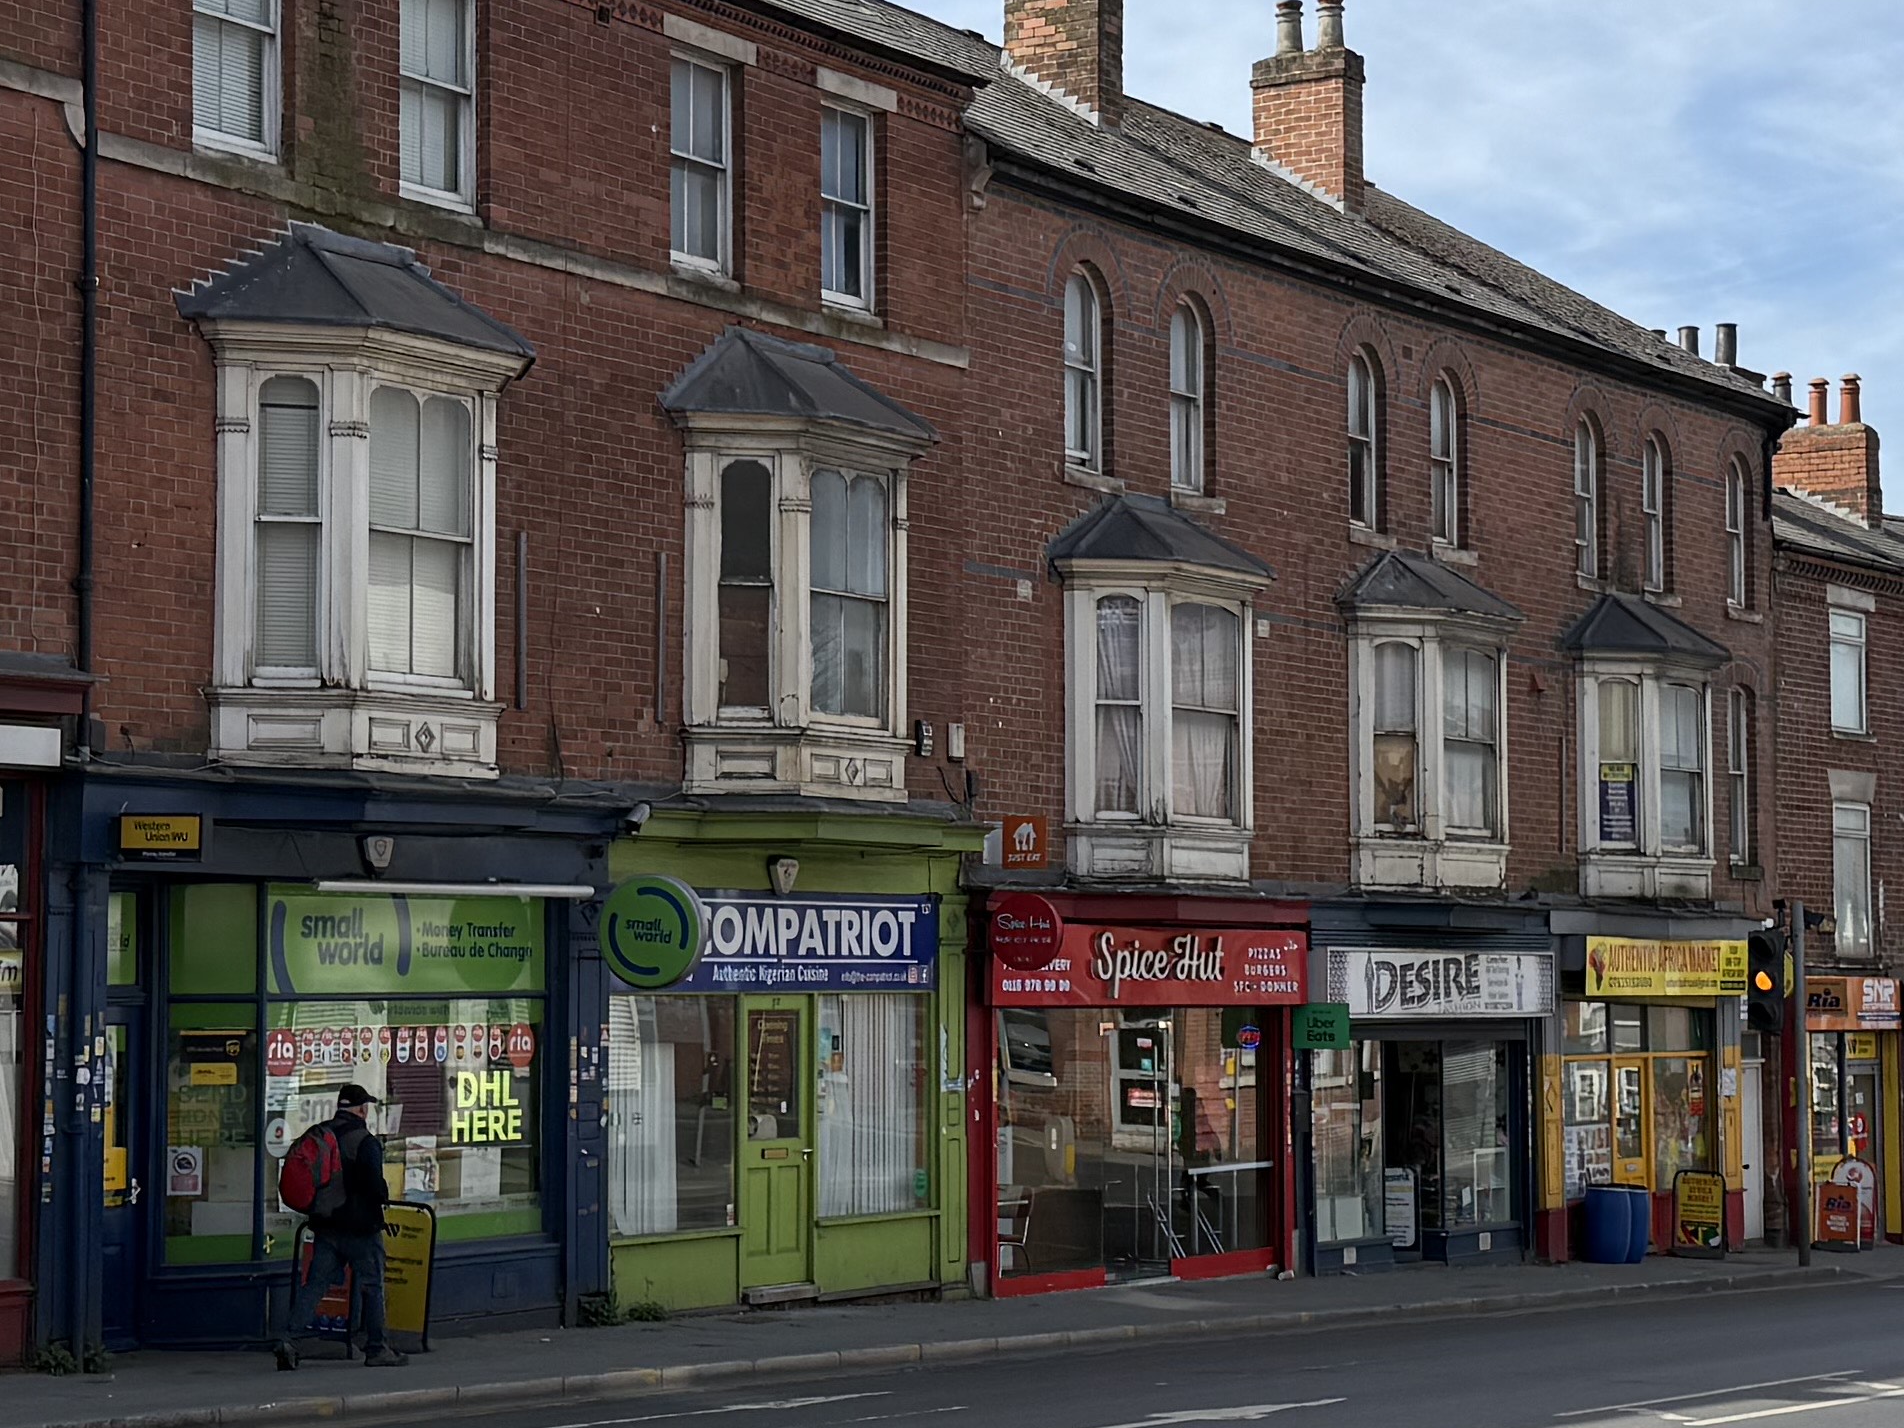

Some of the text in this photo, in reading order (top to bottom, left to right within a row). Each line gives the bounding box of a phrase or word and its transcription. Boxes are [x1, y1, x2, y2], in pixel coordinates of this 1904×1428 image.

[301, 907, 363, 939] small
[421, 922, 516, 941] Money Transfer
[625, 917, 662, 931] small
[633, 929, 672, 945] world
[317, 933, 384, 966] world
[421, 943, 466, 958] Bureau
[469, 943, 485, 958] de
[1247, 947, 1281, 960] PIZZAS
[1609, 944, 1656, 972] AUTHENTIC
[712, 965, 757, 982] Authentic
[1096, 931, 1225, 1000] Spice Hut
[1374, 953, 1482, 1012] DESIRE
[1807, 987, 1841, 1008] Ria
[1307, 1017, 1335, 1029] Uber
[268, 1034, 294, 1058] ria
[509, 1028, 531, 1052] ria
[1307, 1030, 1335, 1042] Eats
[456, 1070, 519, 1109] DHL
[451, 1109, 522, 1143] HERE
